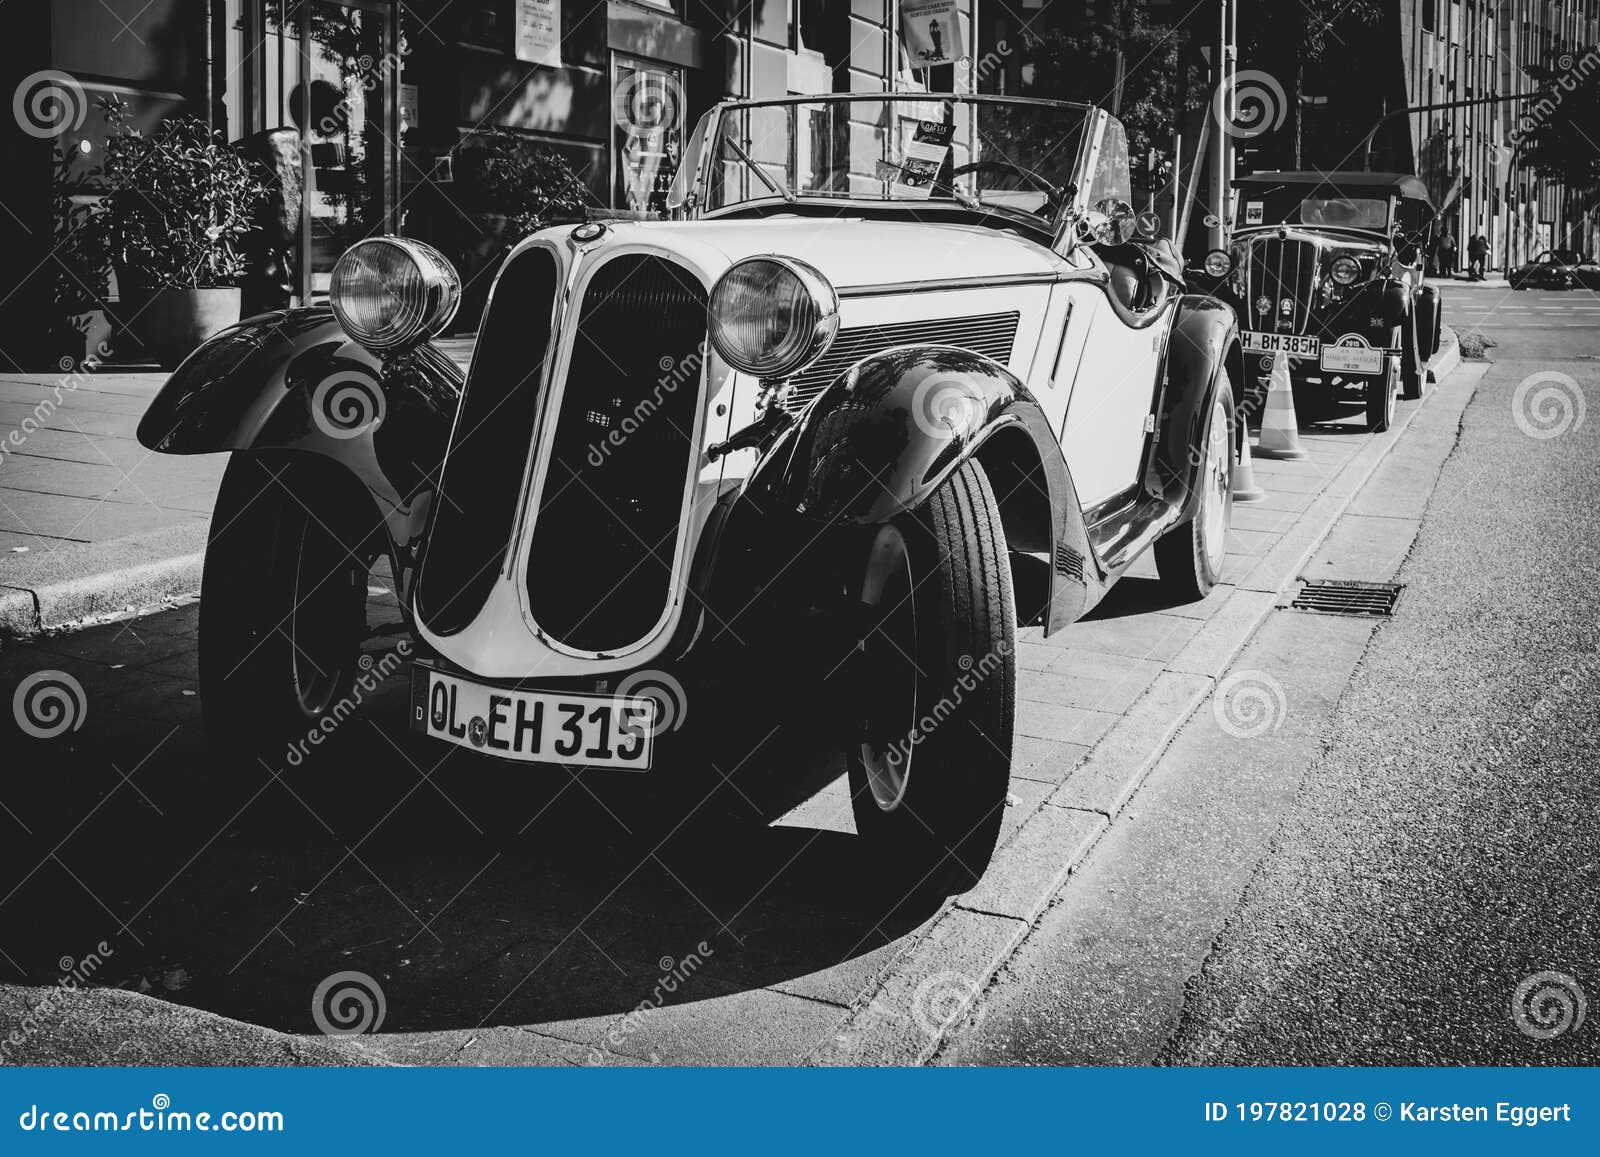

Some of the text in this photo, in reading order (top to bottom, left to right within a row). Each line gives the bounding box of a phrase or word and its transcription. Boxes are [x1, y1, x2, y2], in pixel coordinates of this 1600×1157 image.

[1261, 334, 1280, 351] BM
[1282, 336, 1319, 356] 385H
[416, 706, 423, 720] D
[431, 680, 646, 761] OL EH 315
